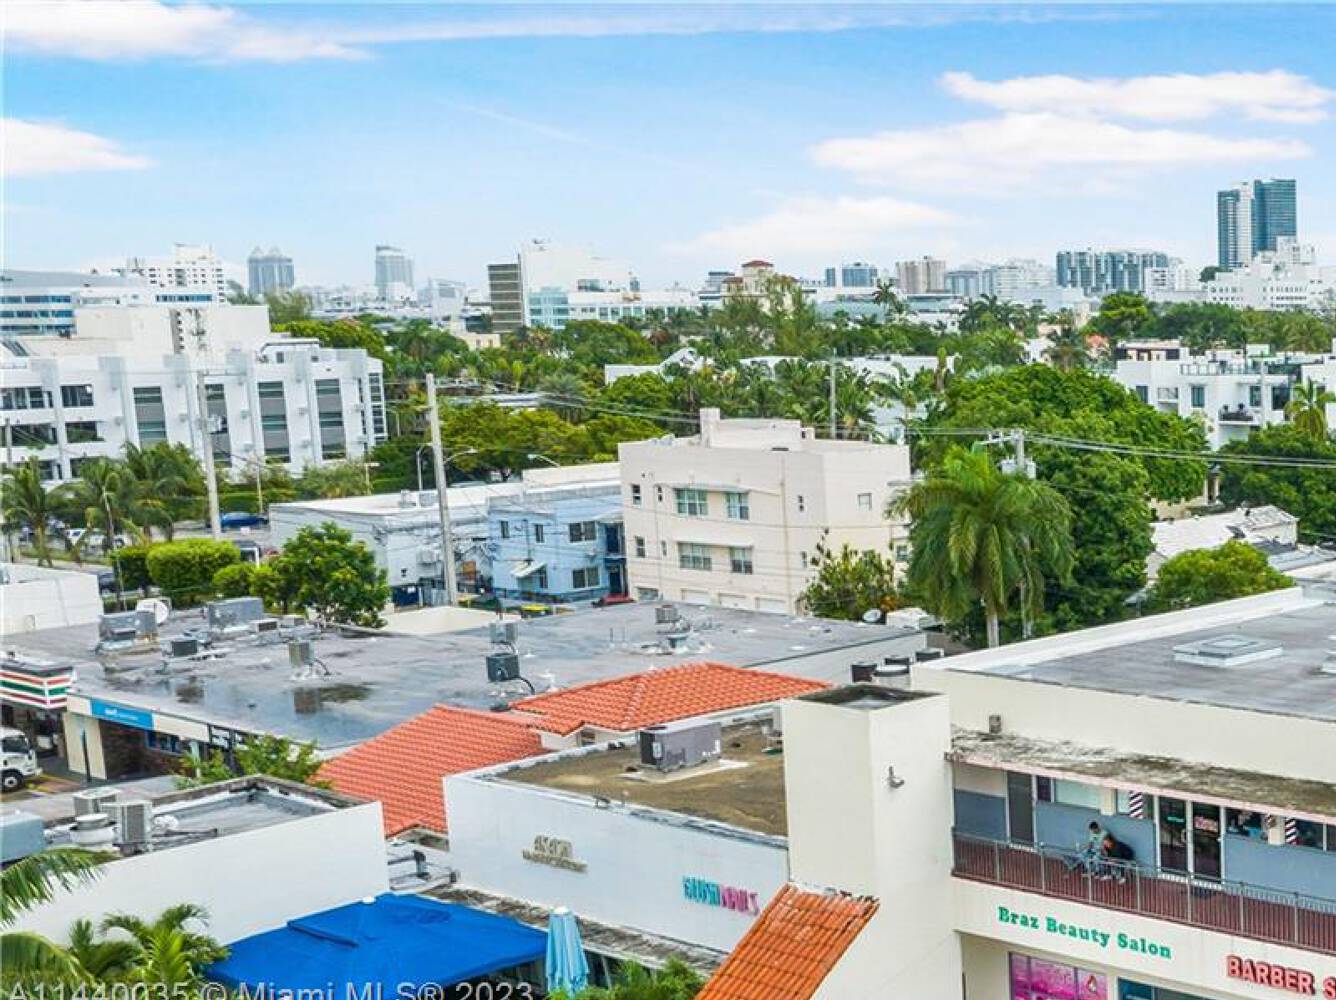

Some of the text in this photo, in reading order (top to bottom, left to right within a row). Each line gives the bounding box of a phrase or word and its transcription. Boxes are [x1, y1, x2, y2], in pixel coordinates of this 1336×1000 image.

[998, 906, 1172, 959] Braz Beauty Salon
[1227, 954, 1316, 995] BARBER
